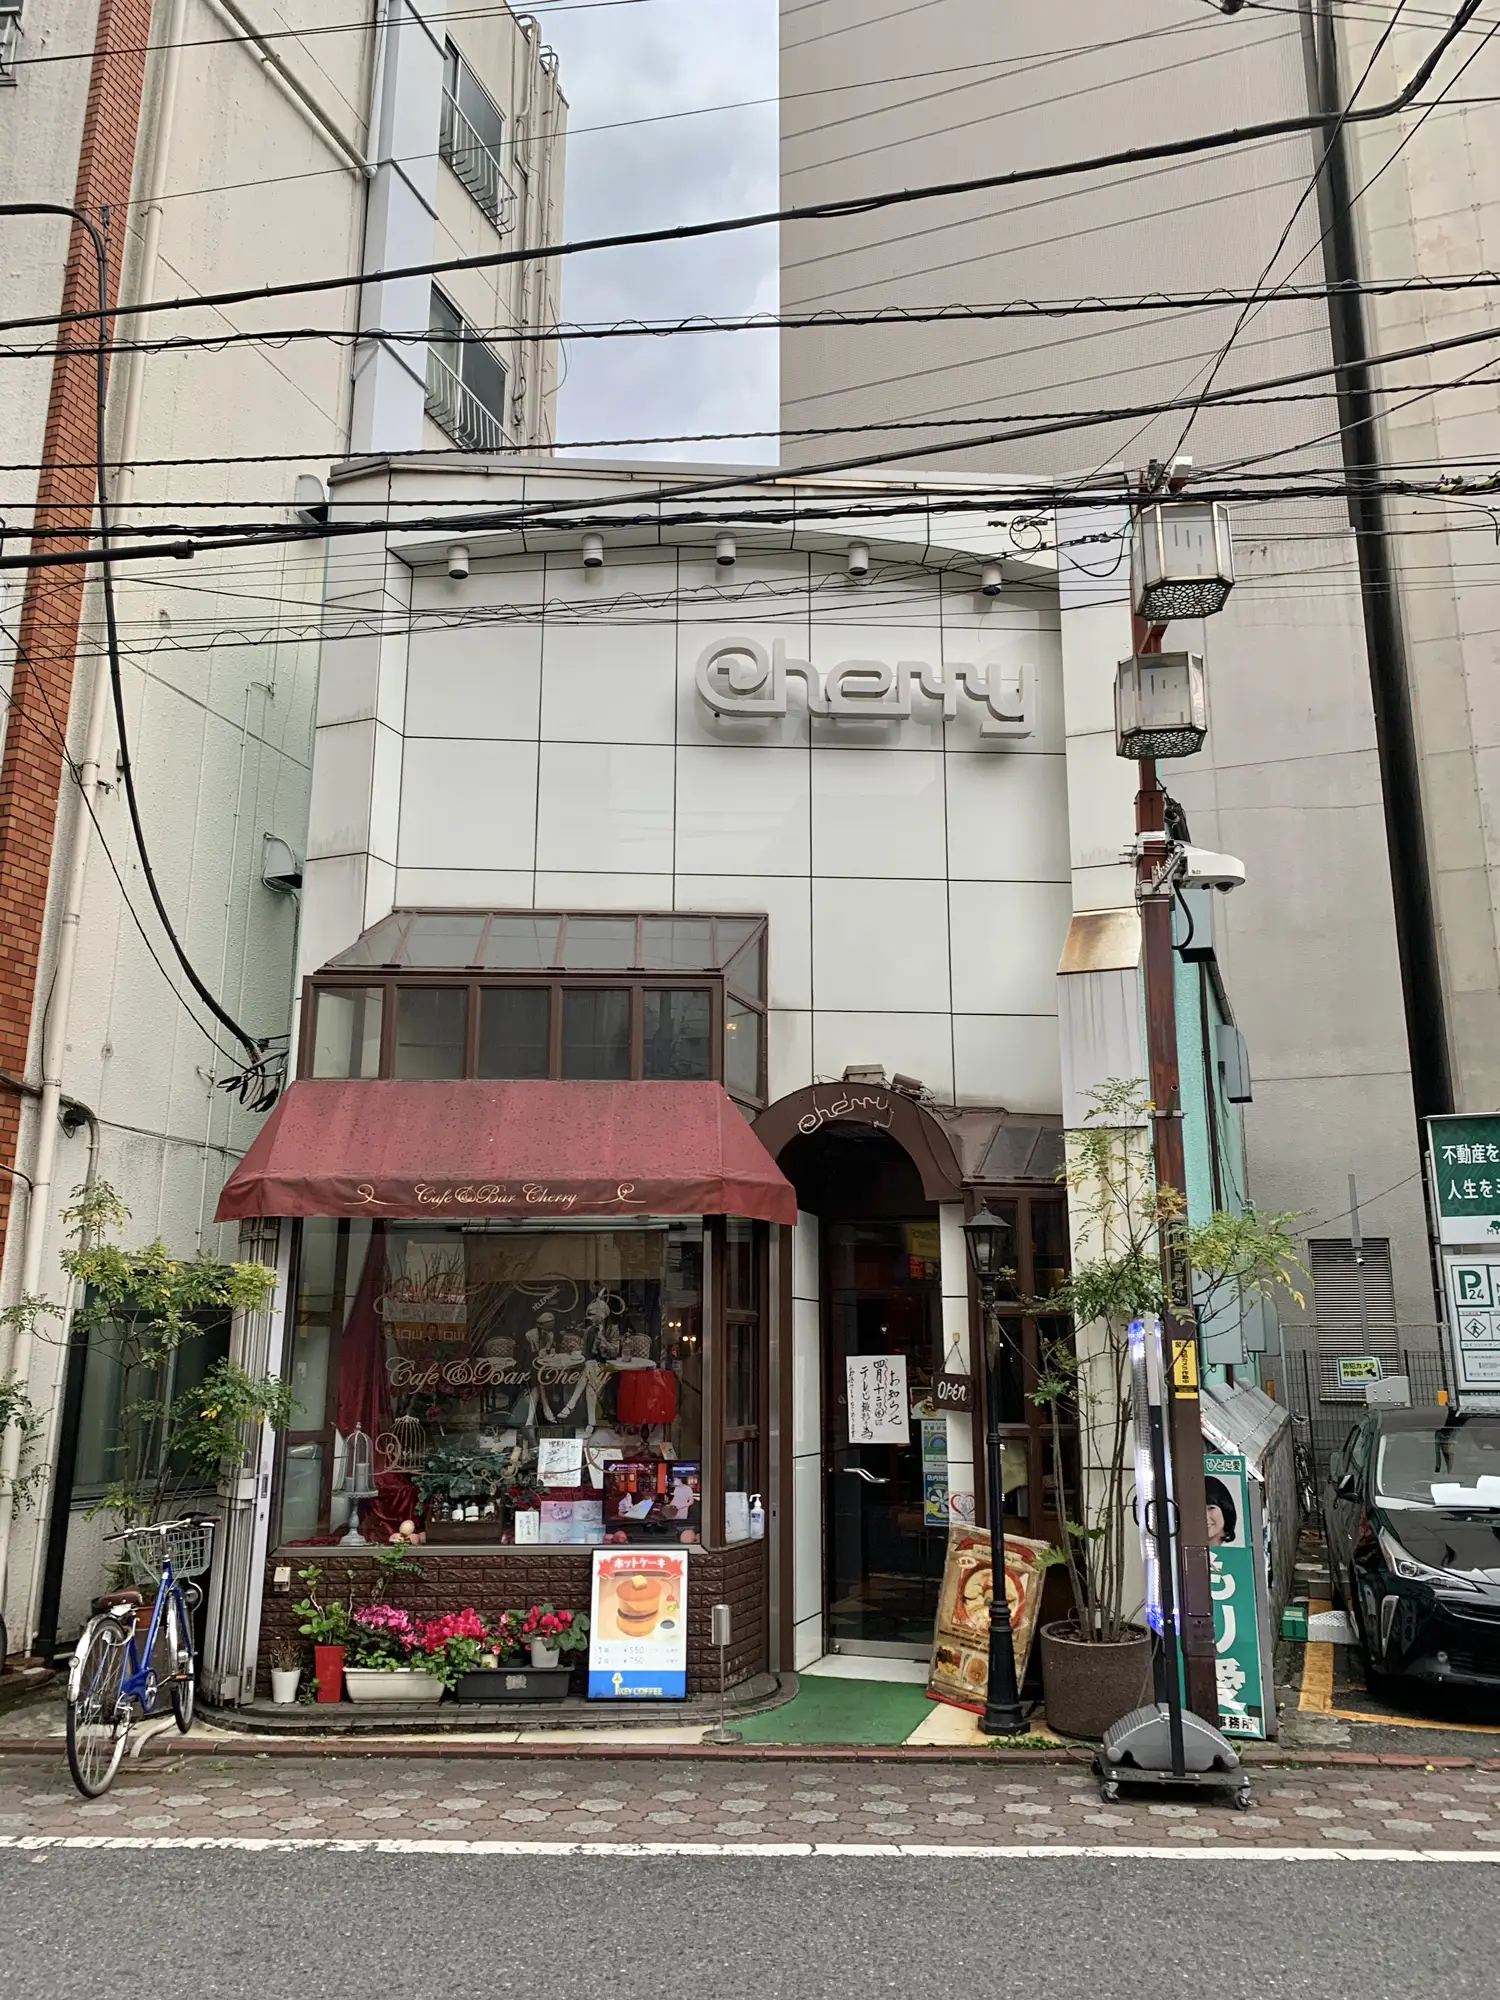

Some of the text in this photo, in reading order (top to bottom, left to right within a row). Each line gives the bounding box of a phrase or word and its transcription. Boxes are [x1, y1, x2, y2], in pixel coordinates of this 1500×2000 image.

[695, 636, 1035, 738] Cherry
[1441, 1143, 1500, 1165] 不動産を
[522, 1183, 578, 1210] Cherry
[1458, 1271, 1482, 1299] P
[1468, 1289, 1485, 1300] 24
[614, 1557, 667, 1569] ホットケーキ
[633, 1687, 664, 1696] COFFEE
